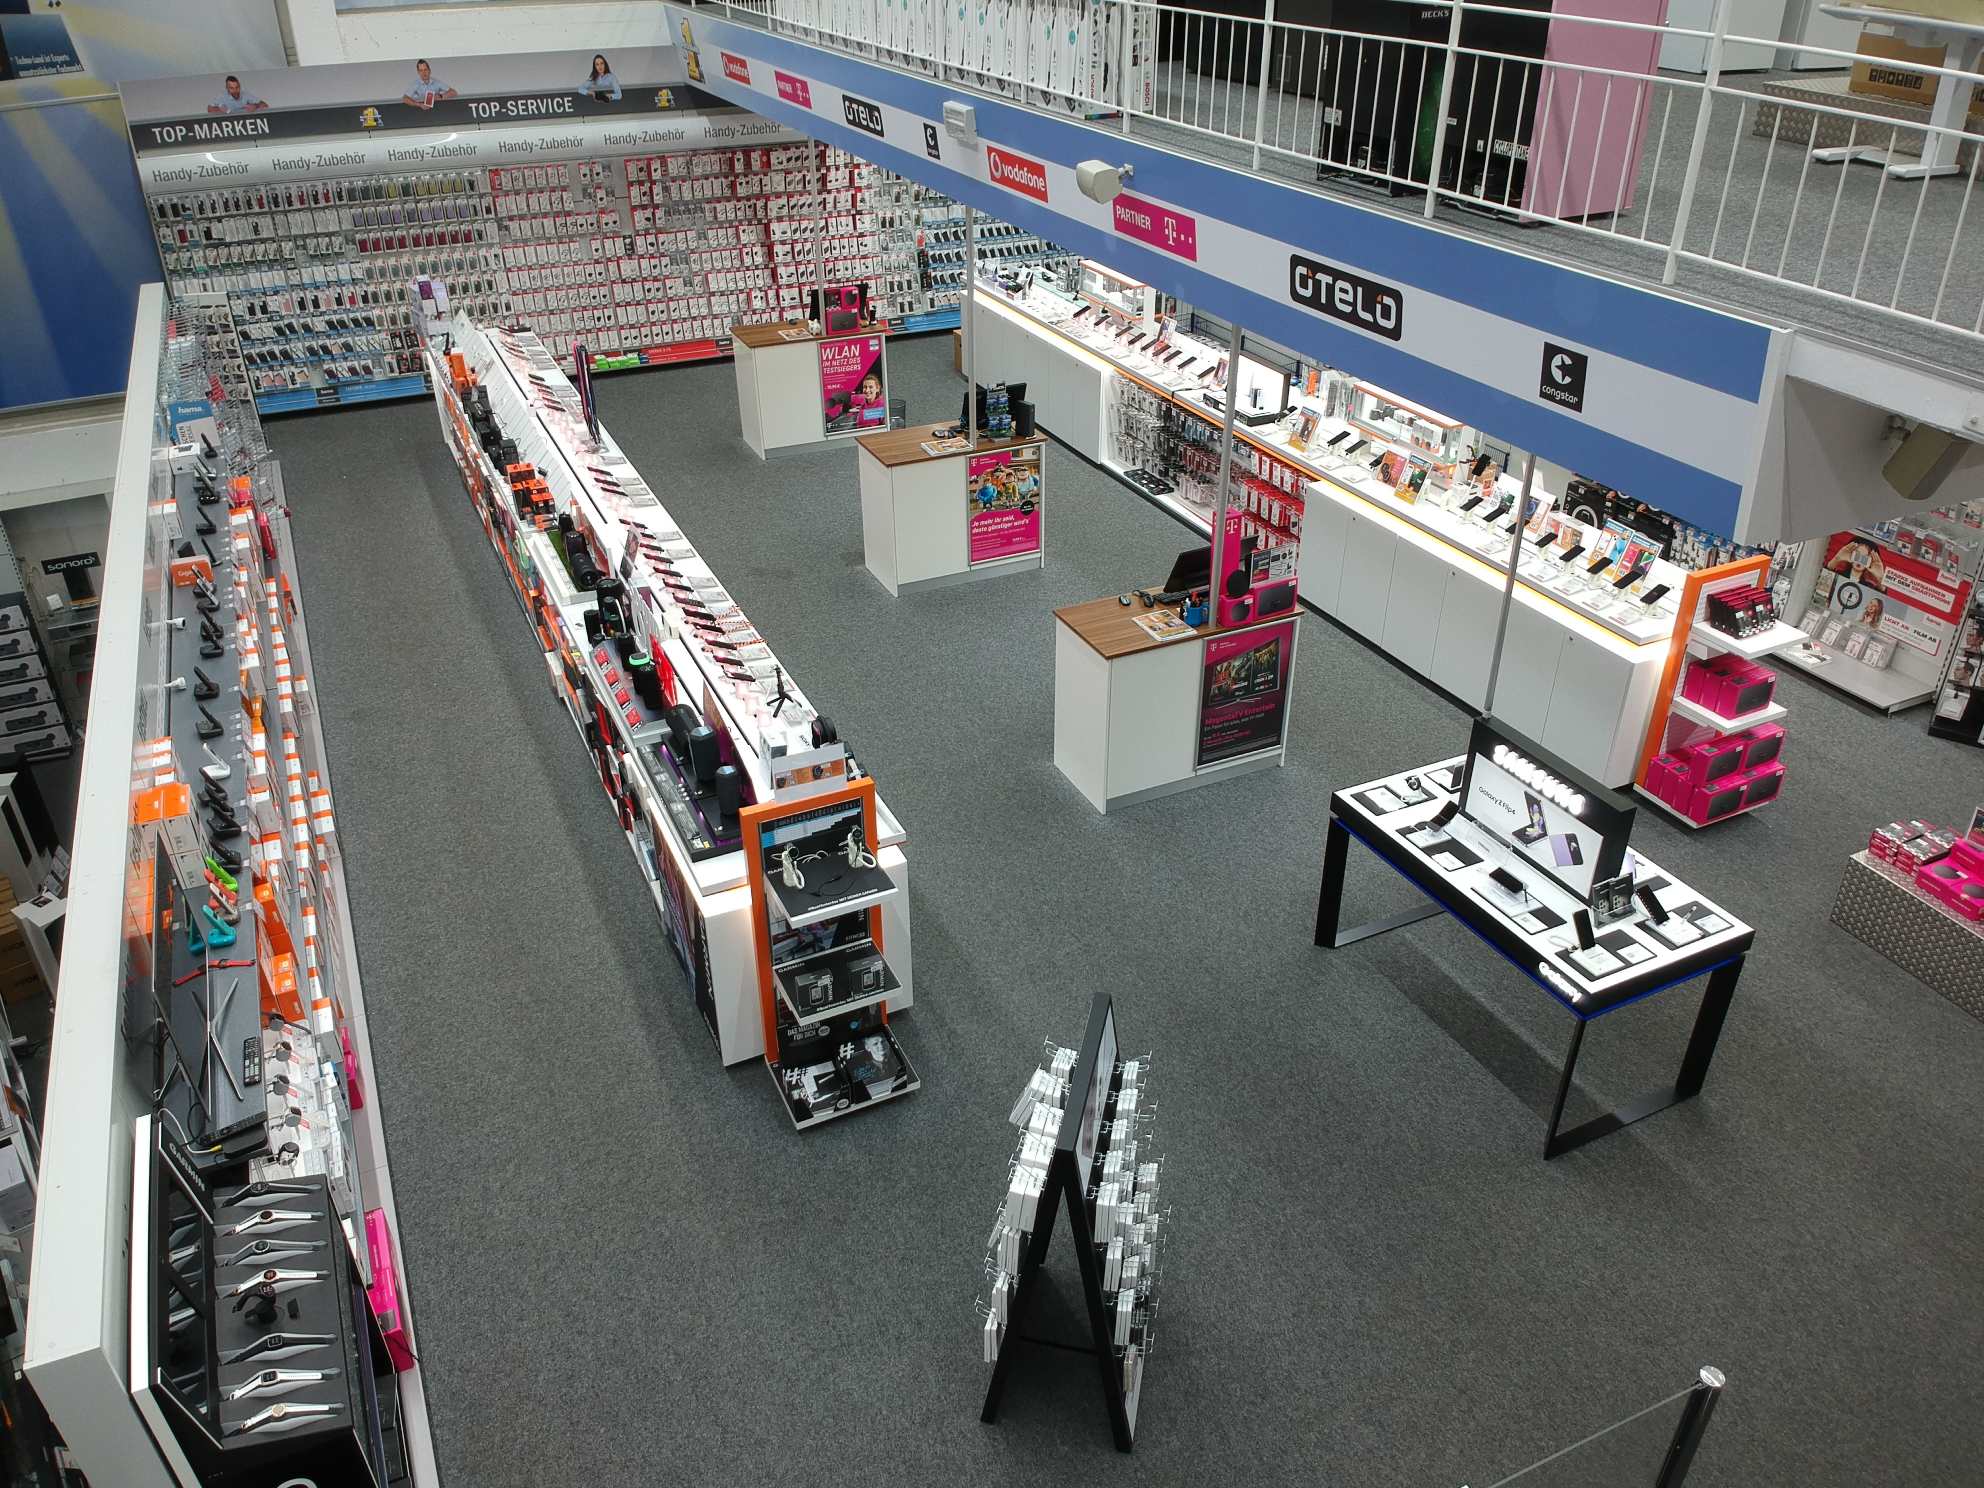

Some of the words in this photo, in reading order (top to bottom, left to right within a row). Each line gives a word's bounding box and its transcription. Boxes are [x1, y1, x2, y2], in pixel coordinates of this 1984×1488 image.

[468, 96, 574, 120] TOP-SERVICE
[152, 117, 271, 144] TOP-MARKEN
[604, 128, 686, 148] Handy-Zubehör
[704, 121, 782, 140] Handy-Zubehör
[388, 142, 478, 163] Handy-Zubehör
[498, 134, 585, 155] Handy-Zubehör
[153, 161, 251, 185] Handy-Zubehör
[272, 151, 367, 175] Handy-Zubehör
[1002, 162, 1046, 193] vodafone
[1115, 207, 1152, 232] PARTNER
[822, 344, 860, 361] WLAN
[823, 364, 861, 374] TESTSIEGERS
[1542, 384, 1579, 406] congstar
[48, 558, 93, 571] sonoro
[169, 1142, 206, 1192] GARMIN
